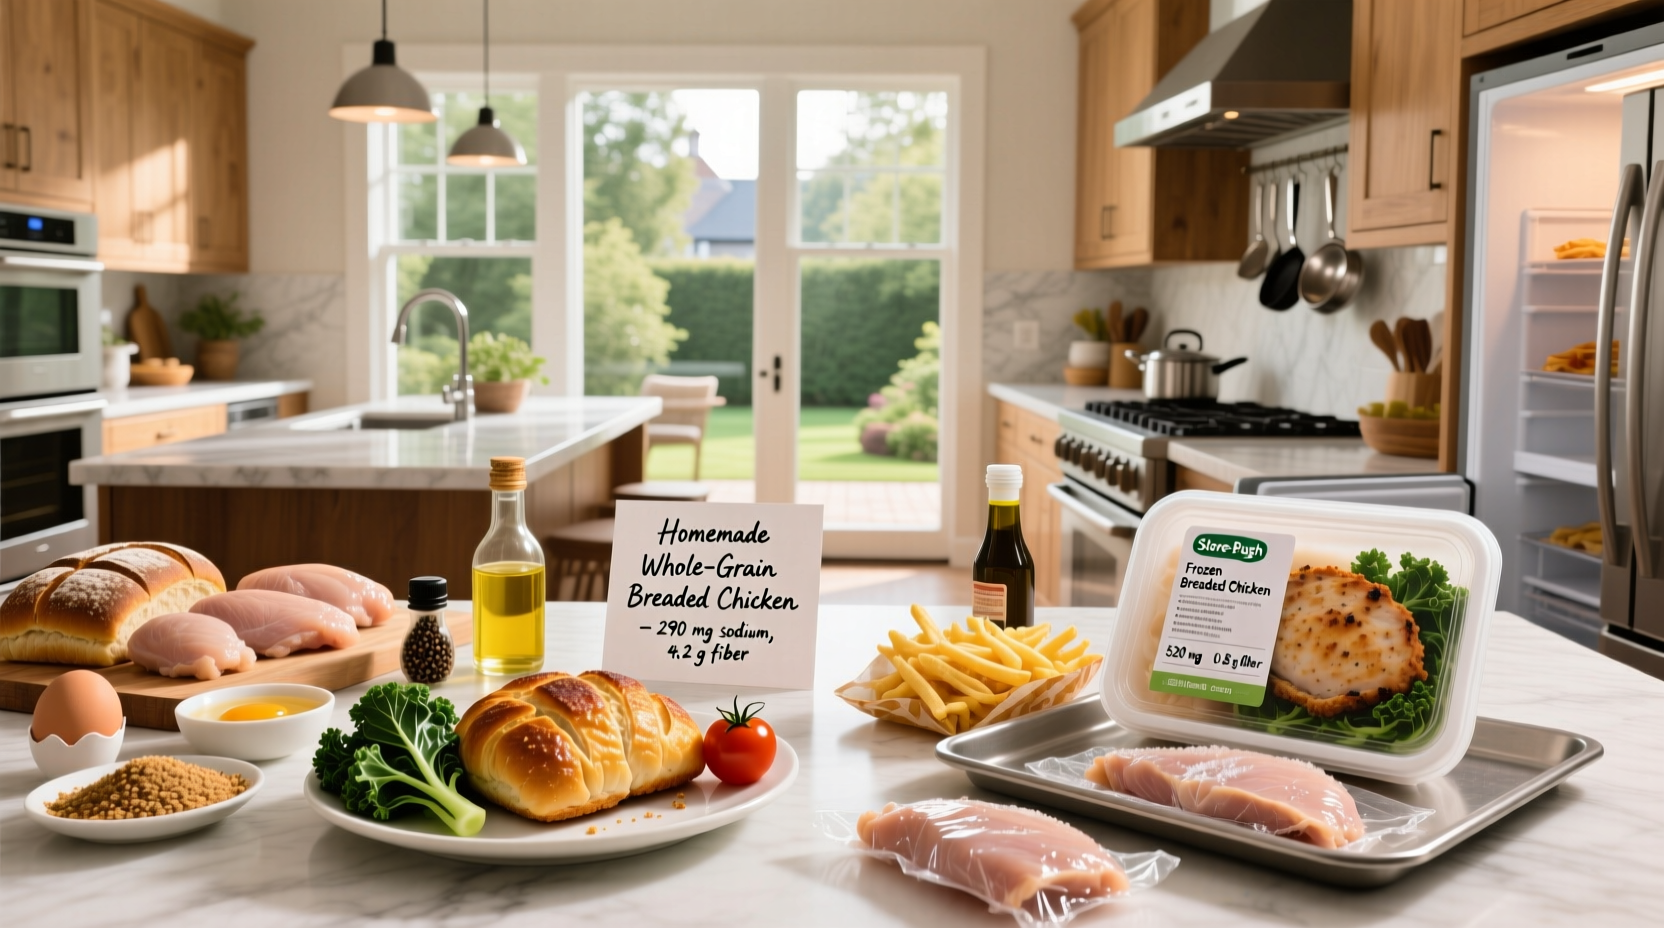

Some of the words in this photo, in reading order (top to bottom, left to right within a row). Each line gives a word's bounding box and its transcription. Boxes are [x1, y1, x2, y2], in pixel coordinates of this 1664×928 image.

[657, 517, 771, 546] Homemade
[641, 552, 778, 579] Whole-Grain
[1185, 562, 1223, 577] Frozen
[627, 583, 711, 609] Breaded
[716, 586, 799, 611] Chicken
[1179, 576, 1227, 593] Breaded
[1228, 580, 1271, 597] Chicken
[656, 620, 687, 637] 290
[691, 626, 714, 644] mg
[718, 621, 774, 644] sodium,
[667, 644, 692, 660] 4.2
[693, 649, 706, 667] g
[710, 643, 750, 664] fiber
[1165, 644, 1187, 659] 520
